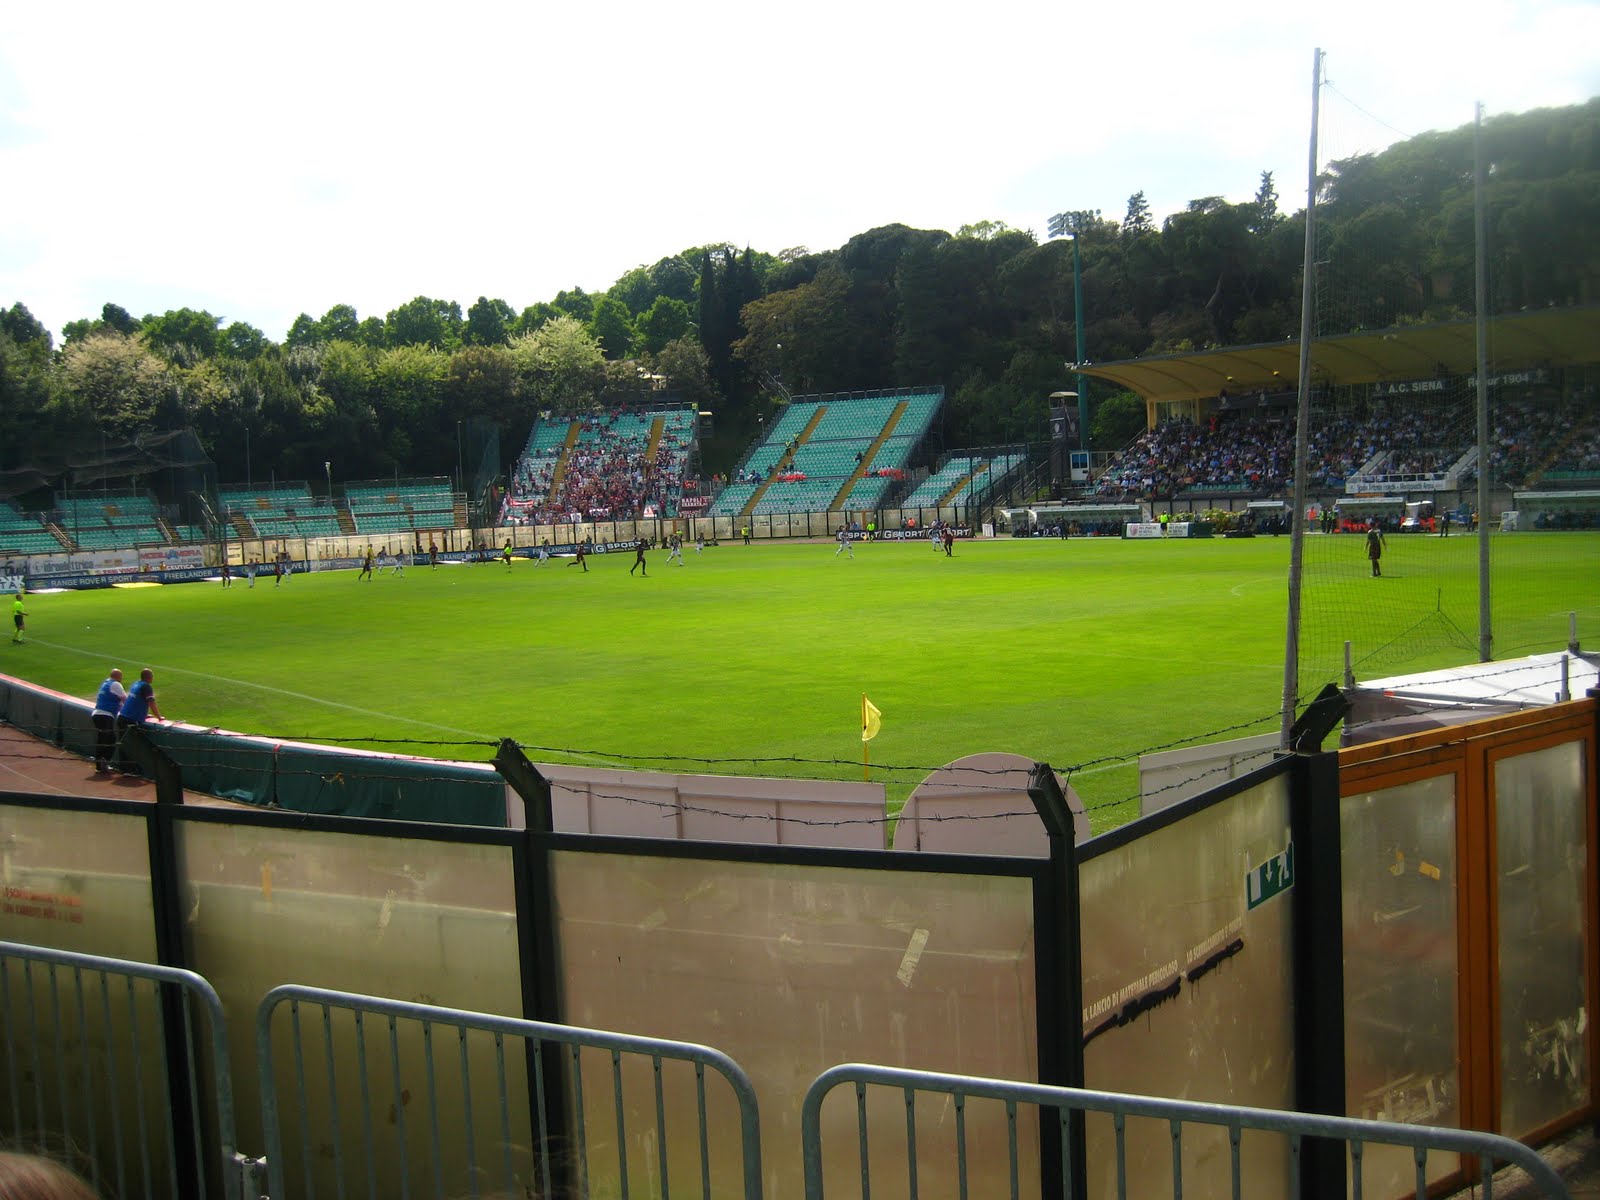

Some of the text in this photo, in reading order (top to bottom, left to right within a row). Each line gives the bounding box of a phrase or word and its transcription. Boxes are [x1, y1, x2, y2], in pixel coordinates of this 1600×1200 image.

[1503, 373, 1529, 385] 1904
[1388, 381, 1443, 395] A.C. SIENA
[51, 579, 78, 588] RANGE
[79, 577, 107, 586] ROVER
[108, 575, 134, 584] SPORT
[164, 570, 213, 580] FREELANDER
[1186, 949, 1193, 964] LO
[1090, 996, 1111, 1019] LANCIO
[1112, 991, 1119, 1008] DI
[1120, 975, 1148, 1003] MATERIALE
[1148, 959, 1178, 988] PERICOLOSO
